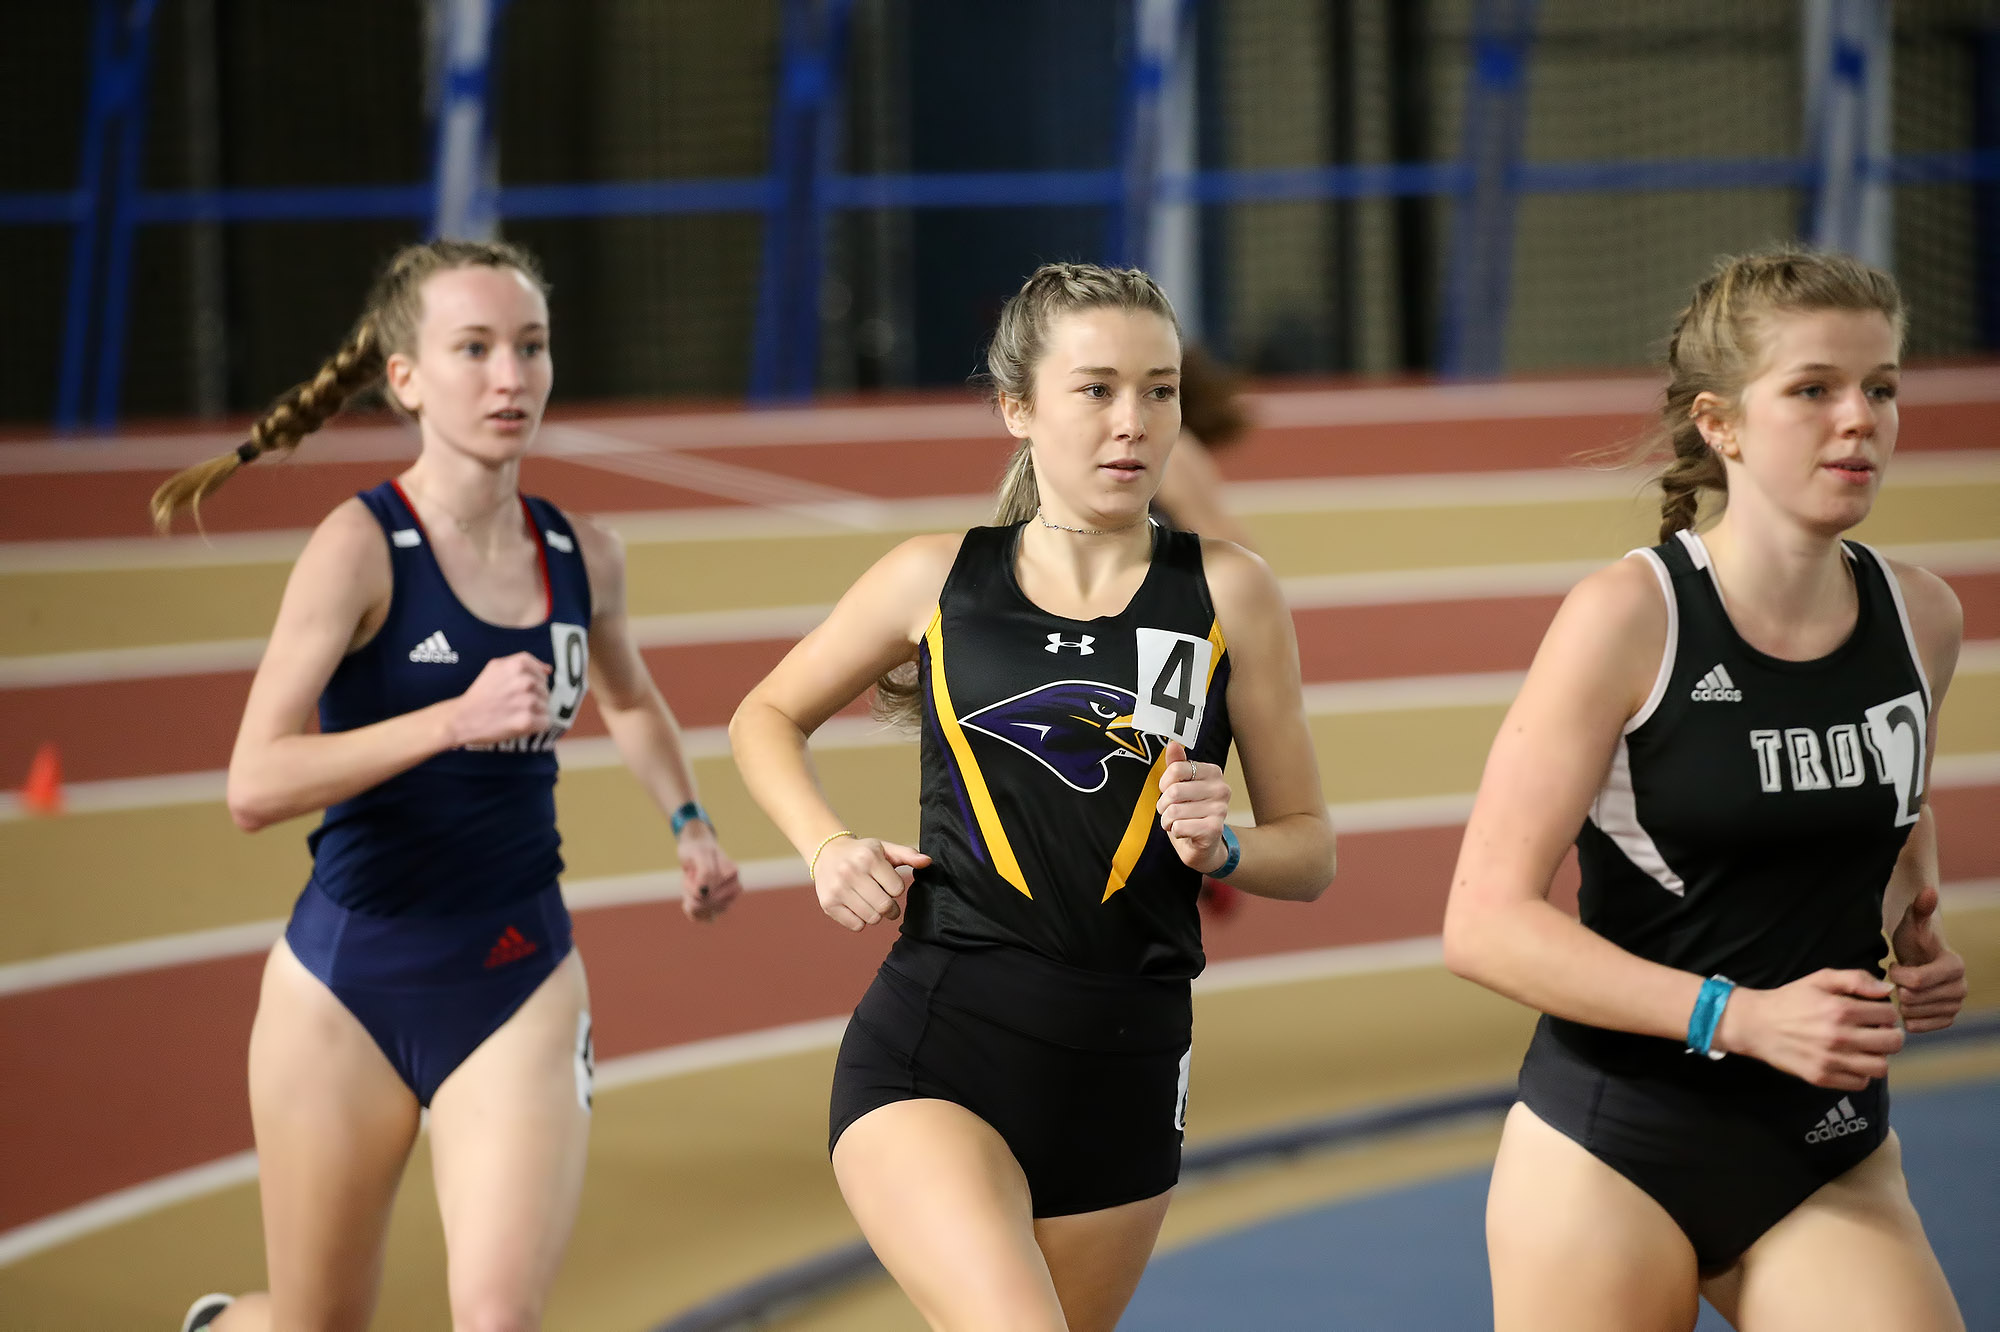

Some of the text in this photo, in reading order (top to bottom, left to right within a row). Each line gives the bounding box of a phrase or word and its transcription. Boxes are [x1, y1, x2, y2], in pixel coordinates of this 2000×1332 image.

[557, 632, 584, 719] 9
[1150, 639, 1195, 736] 4
[1691, 689, 1742, 702] adidas
[1886, 704, 1922, 817] 2
[1805, 1117, 1868, 1144] adidas
